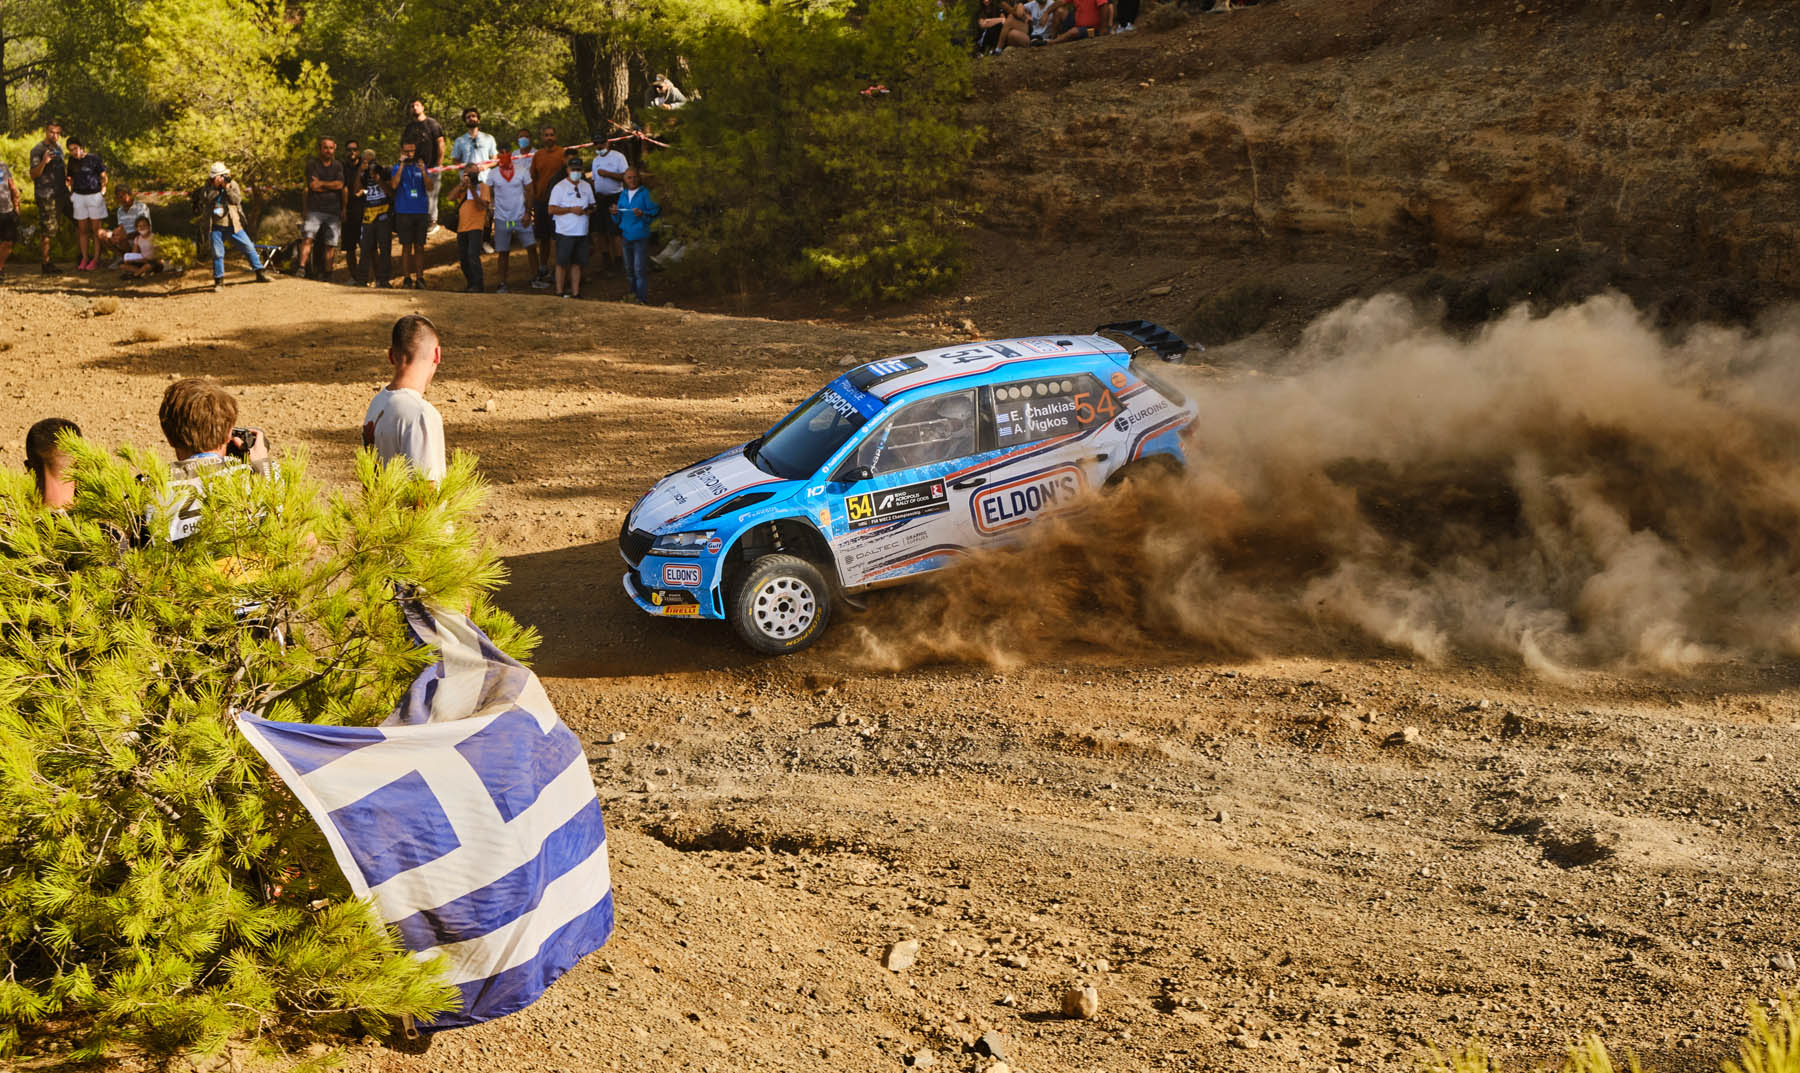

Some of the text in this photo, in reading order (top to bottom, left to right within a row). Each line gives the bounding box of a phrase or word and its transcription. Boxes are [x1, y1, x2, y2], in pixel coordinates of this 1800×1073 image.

[1010, 401, 1077, 422] E. Chalkias
[1073, 389, 1118, 424] 54
[1128, 400, 1168, 424] EUROINS
[1013, 417, 1069, 435] A. Vigkos
[848, 494, 872, 520] 54
[983, 476, 1076, 524] ELDON'S
[666, 569, 698, 581] ELDON'S
[665, 605, 697, 614] PIRELLI
